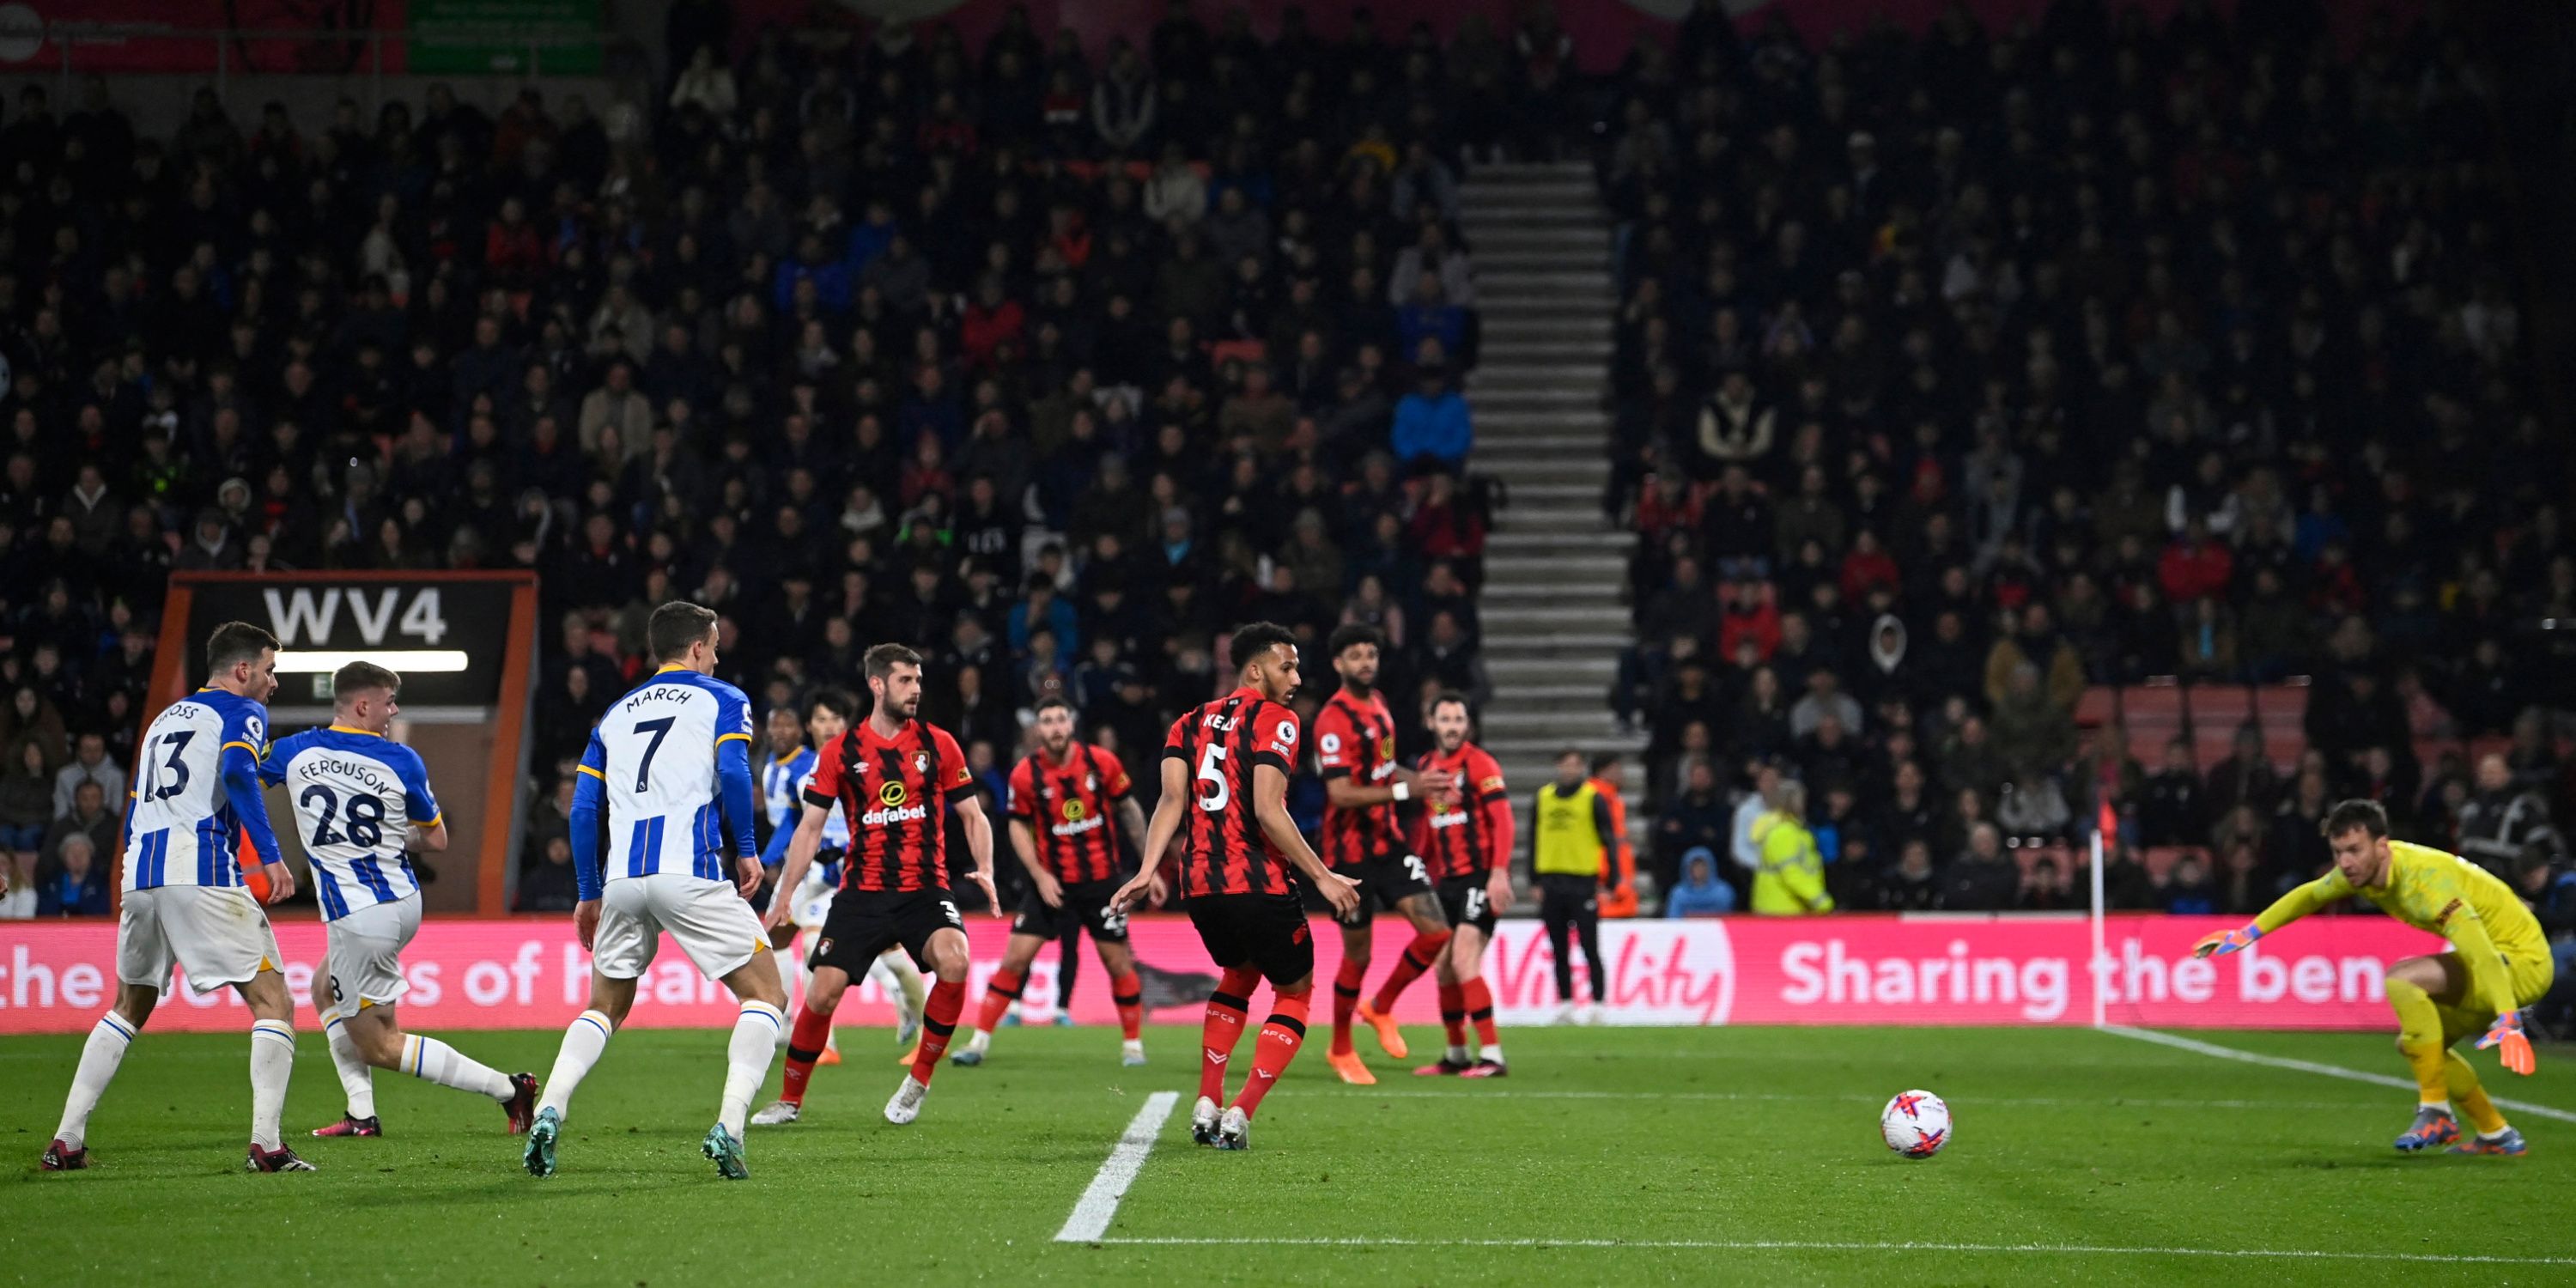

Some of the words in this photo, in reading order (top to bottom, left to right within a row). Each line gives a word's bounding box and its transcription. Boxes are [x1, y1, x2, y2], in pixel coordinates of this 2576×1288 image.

[264, 587, 447, 646] WV4
[626, 687, 693, 714] MARCH
[143, 730, 197, 804] 13
[299, 758, 391, 796] FERGUSON
[632, 715, 677, 794] 7
[1197, 742, 1229, 811] 5
[300, 784, 386, 848] 28
[862, 804, 927, 826] dafabet
[464, 940, 544, 1007] of
[1780, 939, 2069, 1022] Sharing
[2087, 938, 2217, 1004] the
[1206, 1009, 1236, 1024] AFCB
[1261, 1029, 1293, 1046] AFCB
